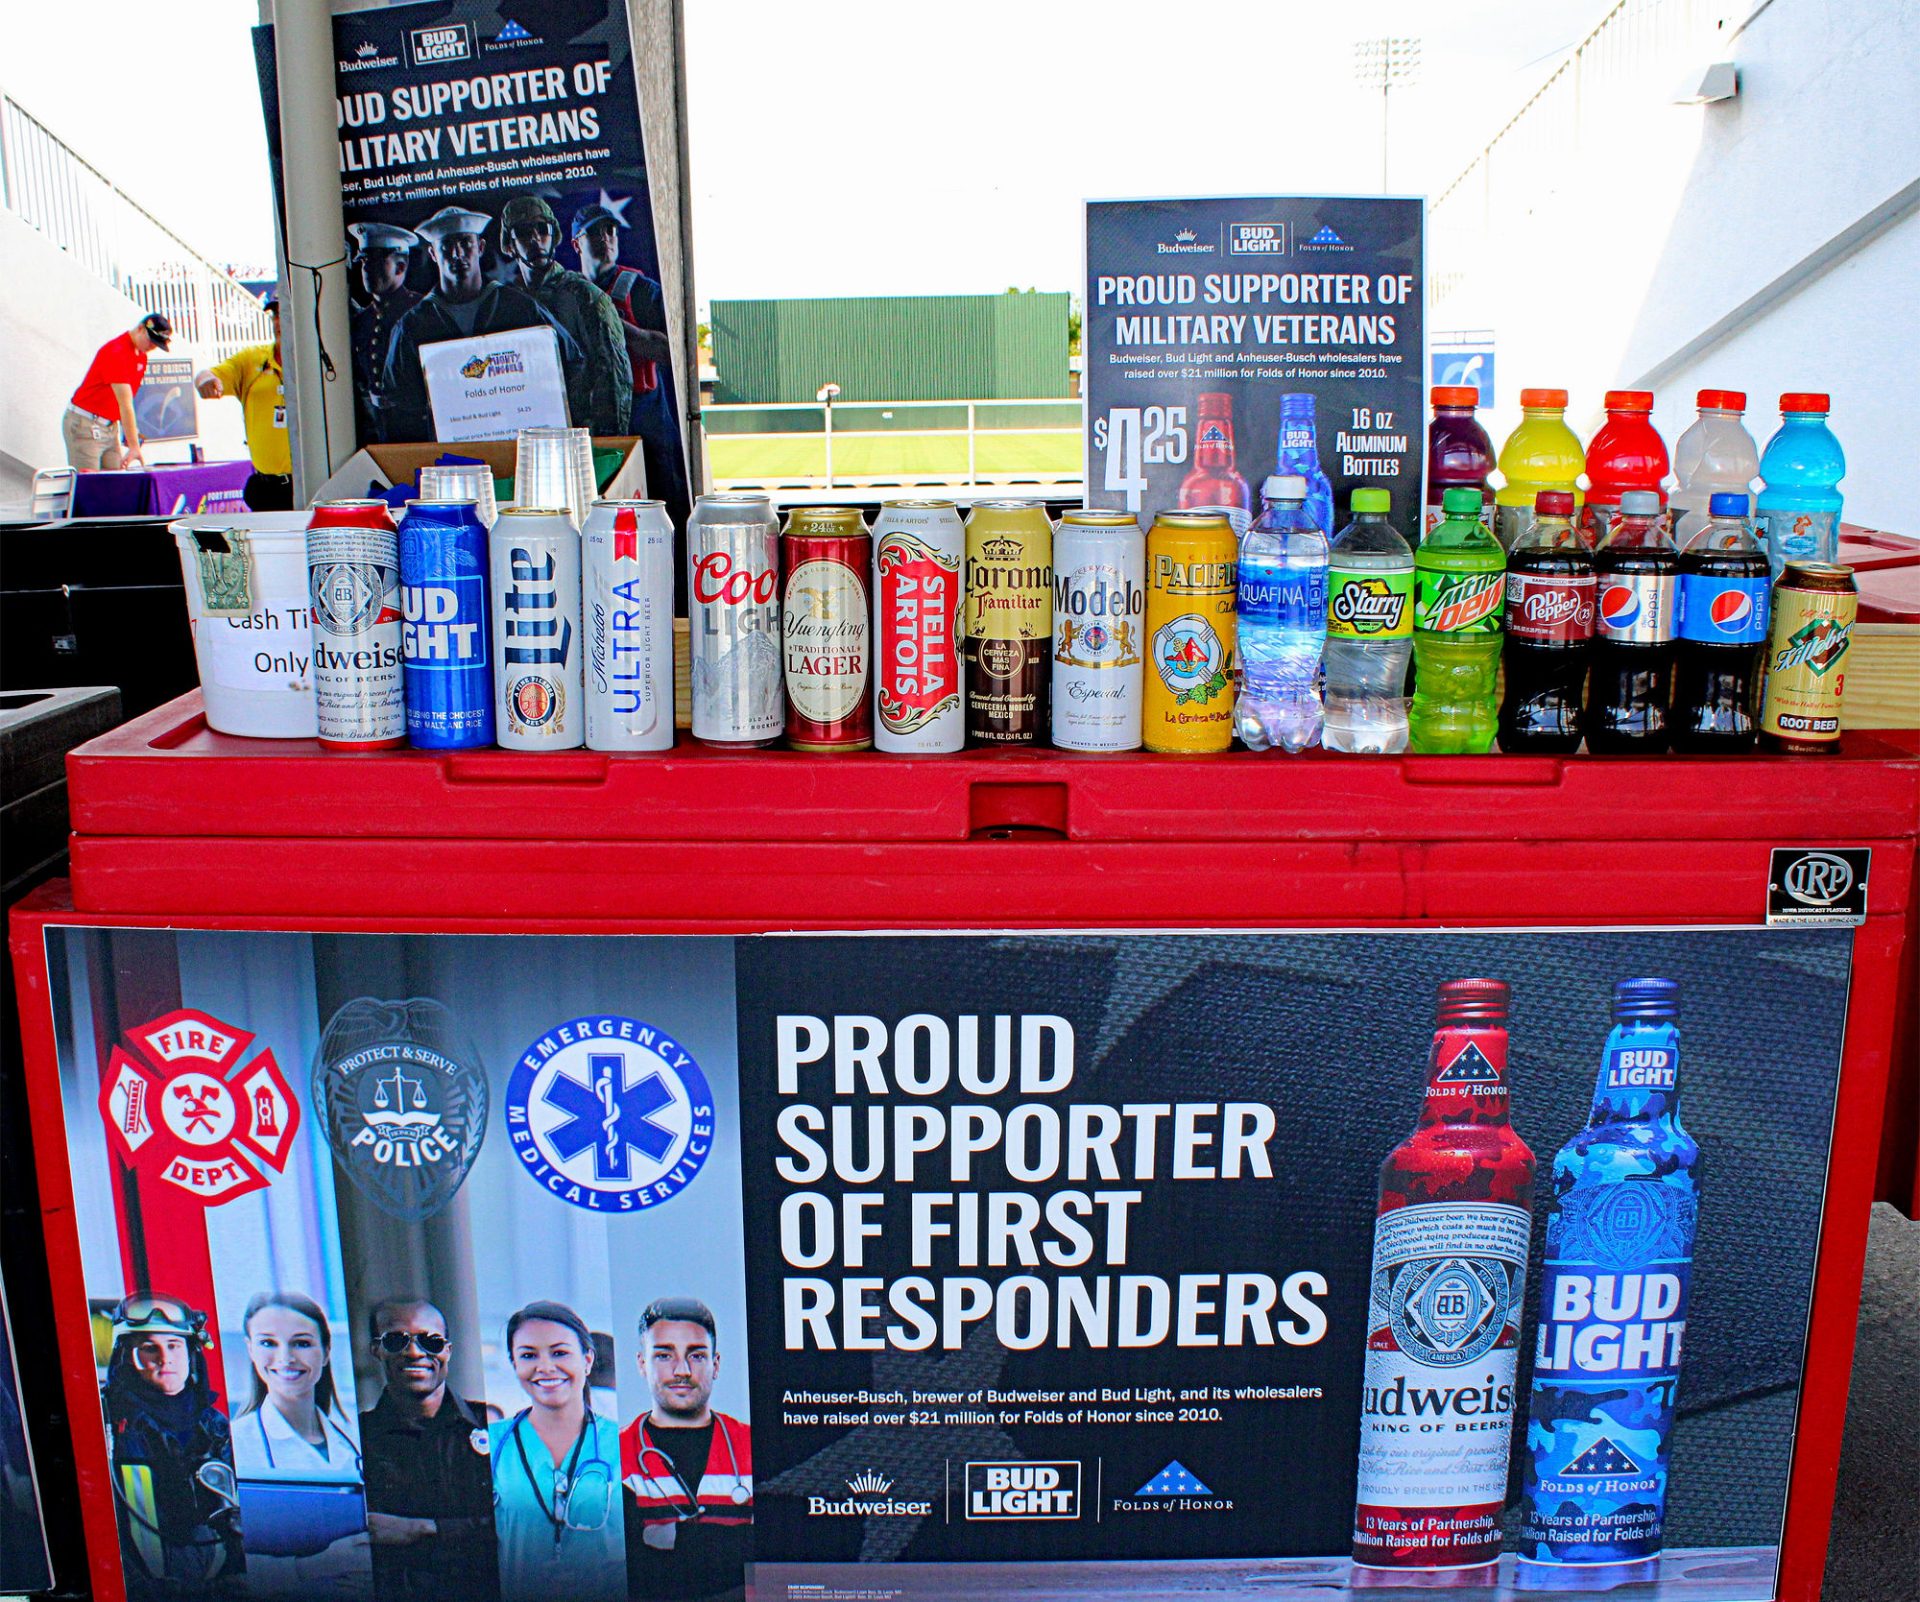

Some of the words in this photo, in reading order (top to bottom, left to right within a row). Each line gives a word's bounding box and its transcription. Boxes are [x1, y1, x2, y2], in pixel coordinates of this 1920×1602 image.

[421, 28, 458, 47] BUD
[339, 56, 399, 73] Budweiser
[416, 42, 467, 62] LIGHT
[392, 67, 569, 122] SUPPORTER
[573, 60, 612, 97] OF
[338, 127, 442, 173] ILITARY
[447, 106, 600, 157] VETERANS
[364, 178, 385, 190] Bud
[386, 172, 412, 188] Light
[414, 169, 434, 182] and
[436, 157, 520, 179] Anheuser-Busch
[521, 150, 583, 168] wholesalers
[585, 148, 611, 160] have
[359, 195, 379, 206] over
[381, 190, 403, 204] $21
[405, 185, 441, 200] million
[443, 183, 458, 195] for
[459, 178, 488, 192] Folds
[489, 176, 500, 189] of
[502, 172, 534, 187] Honor
[535, 170, 563, 183] since
[565, 165, 597, 180] 2010.
[1233, 239, 1282, 252] LIGHT
[1240, 227, 1275, 240] BUD
[1157, 242, 1215, 254] Budweiser
[1097, 274, 1197, 306] PROUD
[1204, 274, 1371, 305] SUPPORTER
[1377, 274, 1413, 304] OF
[1115, 314, 1247, 346] MILITARY
[1253, 314, 1396, 345] VETERANS
[1109, 353, 1163, 366] Budweiser,
[1165, 354, 1186, 364] Bud
[1188, 354, 1213, 366] Light
[1215, 354, 1234, 364] and
[1236, 353, 1317, 364] Anheuser-Busch
[1318, 353, 1377, 364] wholesalers
[1378, 354, 1403, 364] have
[1123, 368, 1155, 379] raised
[1157, 371, 1179, 379] over
[1180, 367, 1202, 379] $21
[1204, 368, 1238, 379] million
[1240, 368, 1255, 379] for
[1256, 368, 1283, 379] Folds
[1285, 368, 1296, 379] of
[1298, 368, 1328, 379] Honor
[1330, 368, 1356, 379] since
[1358, 368, 1388, 379] 2010.
[465, 388, 487, 398] Folds
[489, 386, 498, 396] of
[500, 384, 526, 394] Honor
[1352, 408, 1370, 429] 16
[1336, 431, 1407, 454] ALUMINUM
[1343, 455, 1400, 477] BOTTLES
[692, 551, 781, 605] Coo
[1154, 554, 1237, 590] PACIFI
[402, 586, 459, 623] UD
[974, 590, 1043, 619] Familiar
[1054, 574, 1143, 617] Modelo
[1238, 581, 1305, 608] AQUAFINA
[1334, 583, 1405, 628] Starry
[1525, 594, 1578, 622] Pepper
[1545, 590, 1566, 607] Dr
[287, 608, 308, 630] Ti
[505, 547, 572, 671] Lite
[705, 604, 781, 636] LIGH
[1647, 589, 1659, 629] pepsi
[1754, 591, 1764, 631] pepsi
[783, 610, 866, 643] Yuengling
[895, 573, 918, 696] ARTOIS
[922, 575, 946, 696] STELLA
[402, 623, 478, 660] GHT
[592, 598, 609, 695] Michelob
[612, 577, 641, 714] ULTRA
[793, 644, 857, 654] TRADITIONAL
[984, 649, 1020, 657] CERVEZA
[255, 652, 309, 678] Only
[313, 642, 405, 670] dweise
[788, 653, 862, 676] LAGER
[1834, 674, 1845, 697] 3
[1780, 716, 1811, 730] ROOT
[1813, 719, 1837, 731] BEER
[1795, 861, 1847, 899] IRP
[158, 1032, 225, 1056] FIRE
[522, 1018, 694, 1072] EMERGENCY
[776, 1014, 1076, 1095] PROUD
[338, 1046, 400, 1076] PROTECT
[402, 1046, 413, 1060] &
[415, 1049, 458, 1076] SERVE
[1619, 1050, 1669, 1069] BUD
[1425, 1085, 1456, 1098] FOLDS
[1458, 1084, 1471, 1097] of
[1472, 1085, 1508, 1096] HONOR
[1608, 1067, 1674, 1087] LIGHT
[351, 1125, 459, 1167] POLICE
[508, 1103, 601, 1209] MEDICAL
[619, 1103, 712, 1210] SERVICES
[775, 1102, 1276, 1184] SUPPORTER
[170, 1162, 240, 1188] DEPT
[779, 1192, 885, 1268] OF
[911, 1190, 1142, 1268] FIRST
[782, 1271, 1329, 1352] RESPONDERS
[1552, 1273, 1681, 1323] BUD
[1534, 1321, 1686, 1371] LIGHT
[782, 1390, 908, 1405] Anheuser-Busch,
[912, 1389, 964, 1404] brewer
[967, 1389, 983, 1404] of
[987, 1389, 1065, 1404] Budweiser
[1069, 1388, 1097, 1403] and
[1101, 1388, 1130, 1402] Bud
[1135, 1388, 1175, 1405] Light,
[1180, 1387, 1207, 1401] and
[1212, 1386, 1231, 1401] its
[1234, 1385, 1323, 1401] wholesalers
[1365, 1375, 1512, 1417] udweis
[783, 1411, 818, 1425] have
[823, 1410, 869, 1425] raised
[873, 1413, 905, 1425] over
[909, 1409, 940, 1426] $21
[944, 1409, 995, 1425] million
[999, 1409, 1020, 1425] for
[1024, 1409, 1065, 1425] Folds
[1069, 1409, 1084, 1425] of
[1087, 1409, 1131, 1424] Honor
[1135, 1408, 1174, 1424] since
[1178, 1408, 1223, 1423] 2010.
[1372, 1422, 1410, 1433] KING
[1420, 1423, 1446, 1433] OF
[1455, 1421, 1505, 1432] BEERS
[986, 1468, 1060, 1490] BUD
[1540, 1479, 1584, 1493] FOLDS
[1587, 1481, 1601, 1495] of
[1605, 1480, 1656, 1492] HONOR
[808, 1496, 932, 1517] Budweiser
[972, 1491, 1074, 1515] LIGHT
[1113, 1499, 1159, 1512] FOLDS
[1161, 1496, 1177, 1513] of
[1179, 1498, 1234, 1511] HONOR
